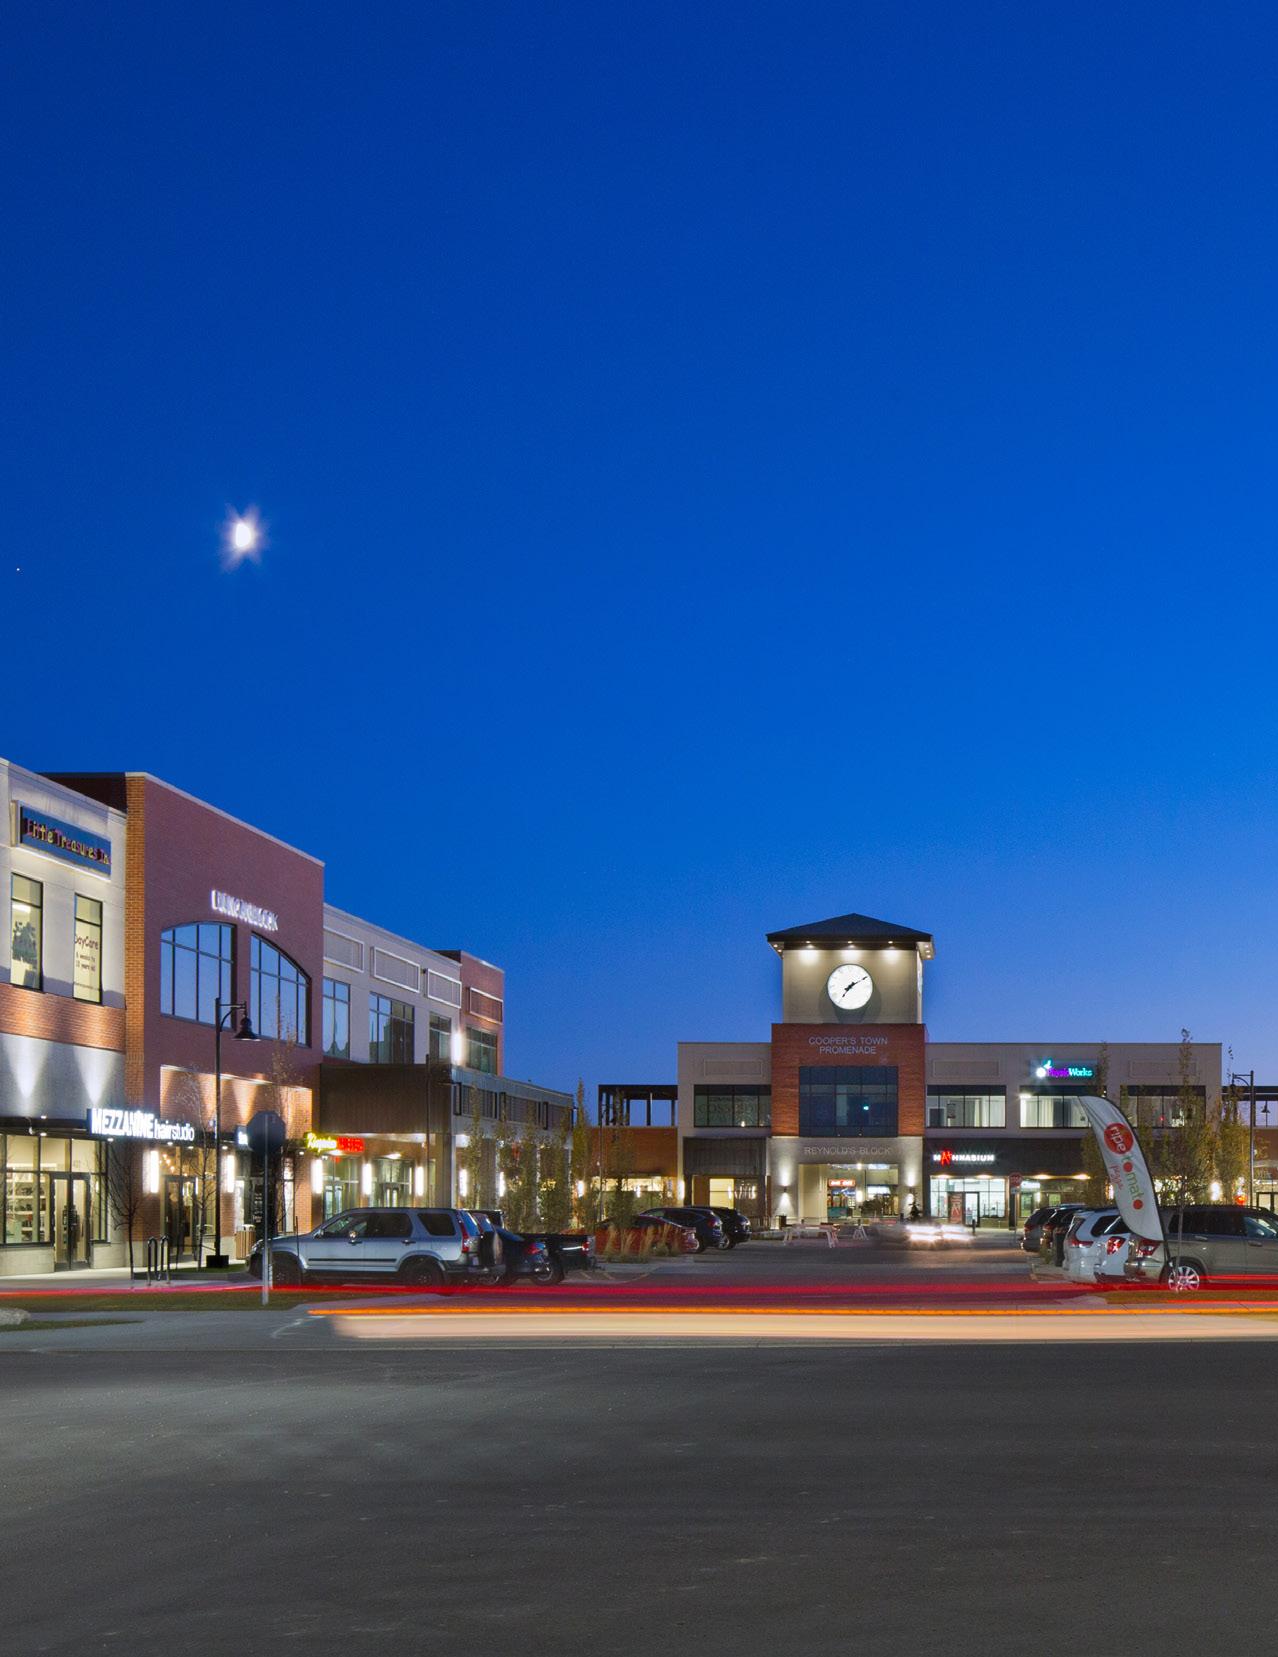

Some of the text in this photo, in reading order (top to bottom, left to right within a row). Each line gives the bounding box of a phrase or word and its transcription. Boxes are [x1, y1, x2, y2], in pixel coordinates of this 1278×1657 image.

[54, 829, 98, 860] Treasures
[808, 1036, 888, 1045] COOPER'S TOWN
[819, 1046, 877, 1055] PROMENADE
[91, 1107, 154, 1139] MEZZANINE
[1109, 1125, 1127, 1152] ripe
[804, 1146, 892, 1156] REYNOLD'S BLOCK
